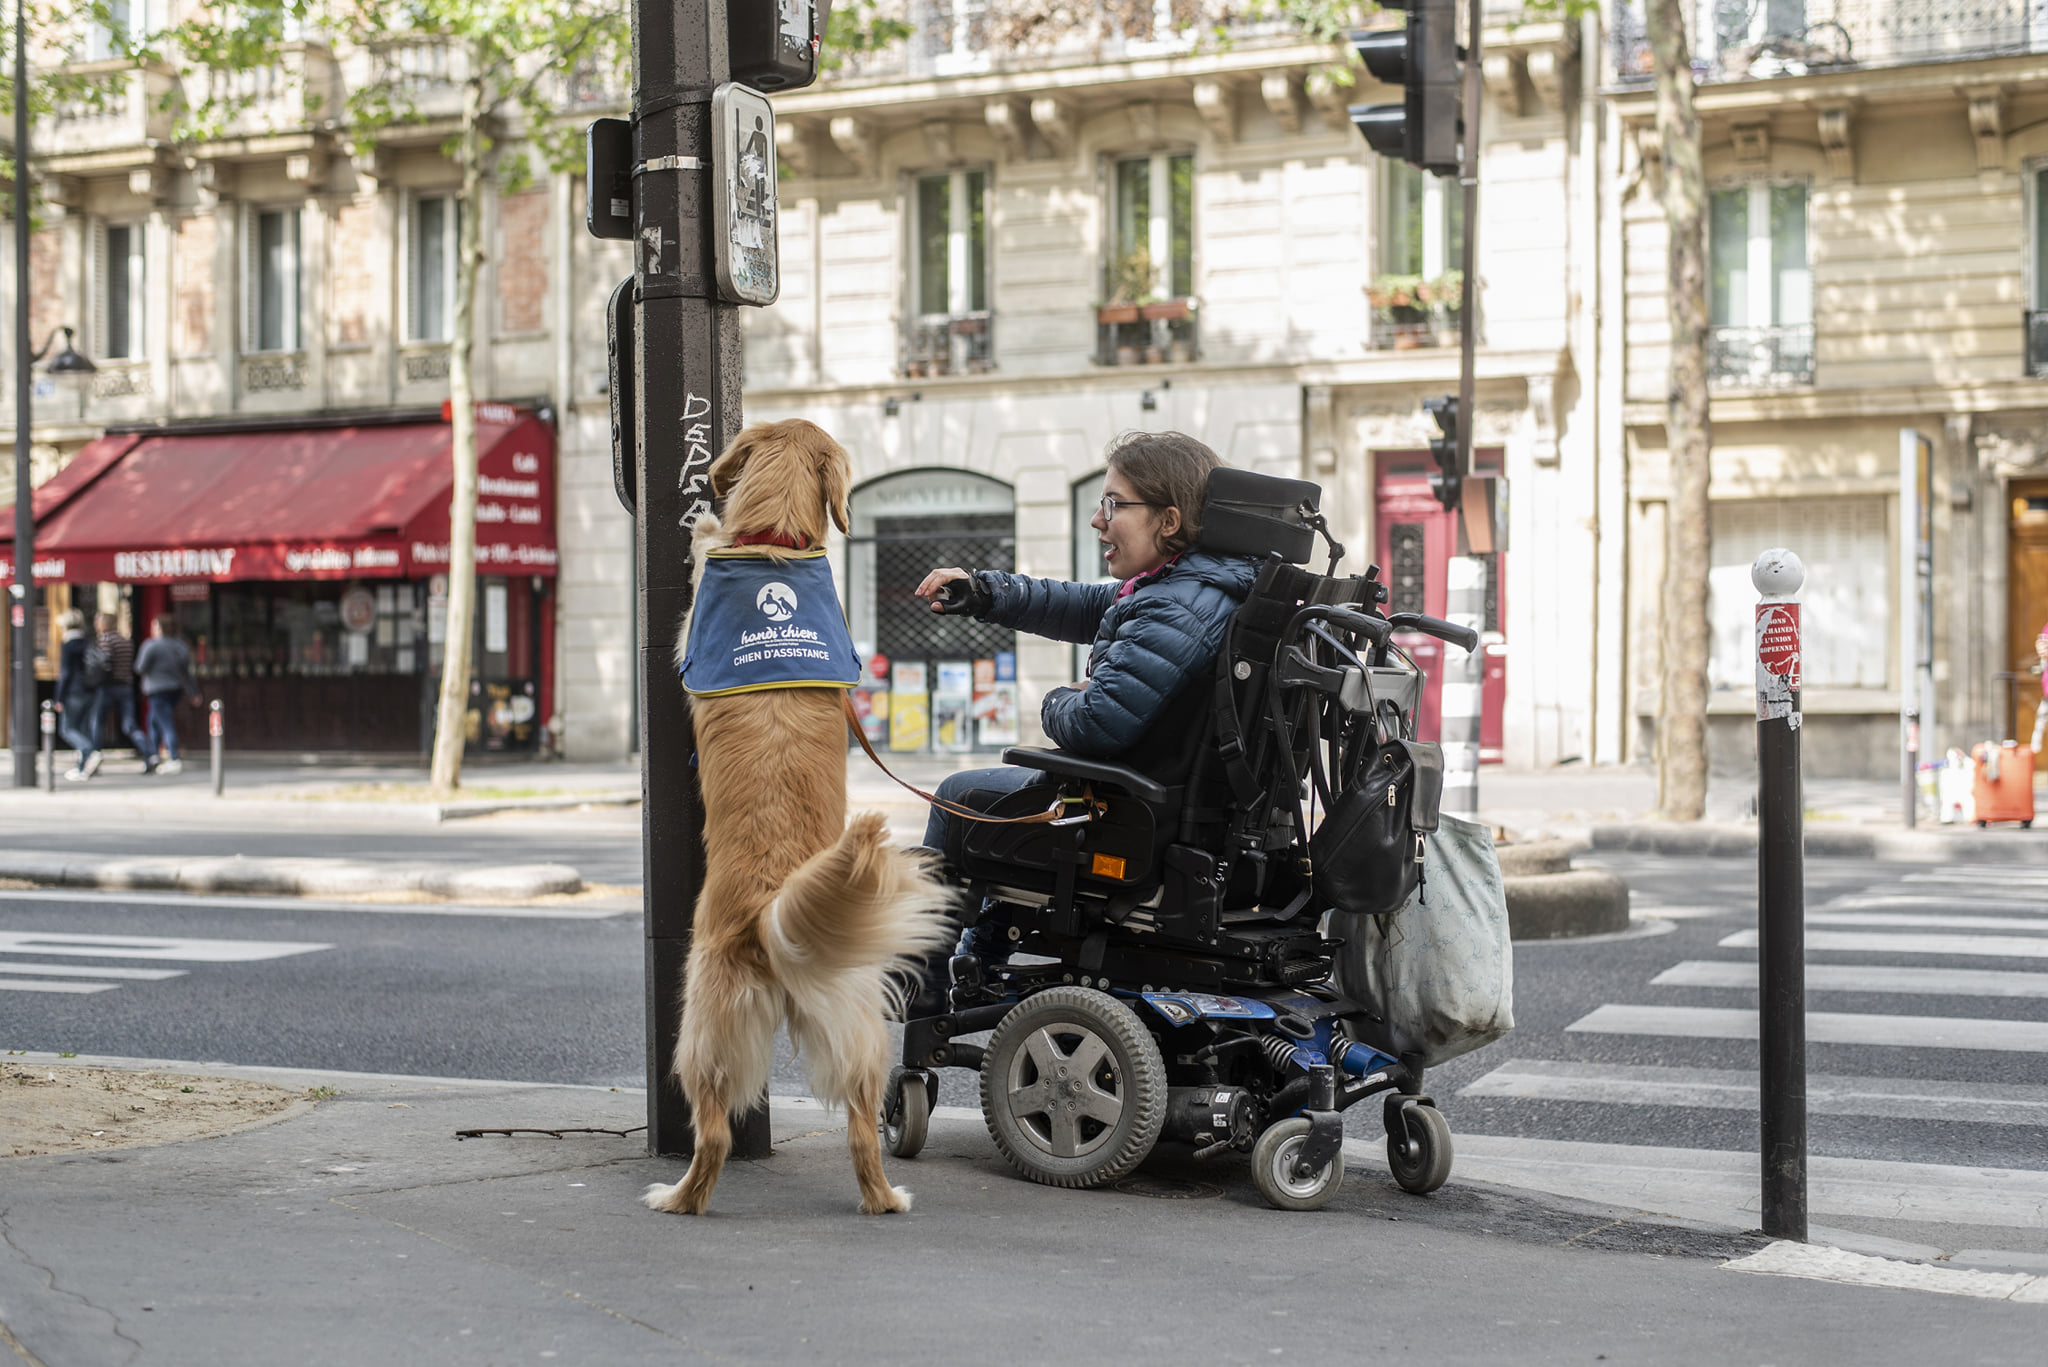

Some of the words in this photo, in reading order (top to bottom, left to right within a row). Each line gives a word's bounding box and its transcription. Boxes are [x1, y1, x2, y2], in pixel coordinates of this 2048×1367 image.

[115, 548, 236, 578] RESTAURANT
[1766, 627, 1793, 635] HAINES
[733, 650, 762, 667] CHIEN
[763, 648, 830, 661] D'ASSISTANCE
